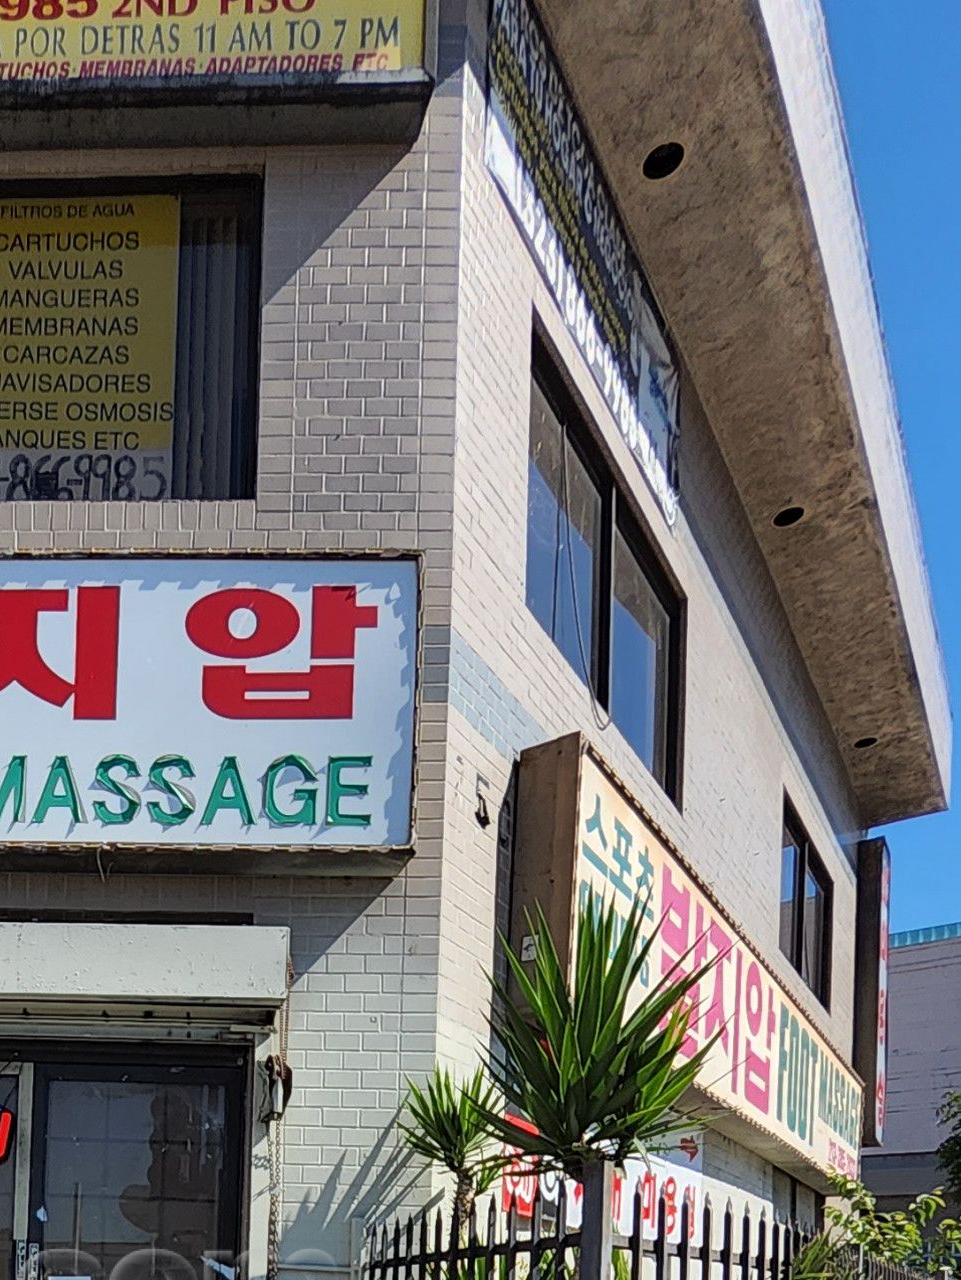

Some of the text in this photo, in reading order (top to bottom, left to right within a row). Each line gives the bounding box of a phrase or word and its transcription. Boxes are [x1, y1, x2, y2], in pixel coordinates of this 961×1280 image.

[14, 26, 68, 58] POR
[80, 23, 181, 56] DETRAS
[194, 22, 216, 53] 11
[228, 19, 272, 52] AM
[285, 18, 322, 51] TO
[333, 18, 348, 50] 7
[359, 15, 399, 49] PM
[78, 57, 196, 79] MEMBRANAS
[205, 53, 344, 75] ADAPTADORES
[0, 202, 135, 219] FILTROS DE AGUA
[8, 260, 124, 281] VALVULAS
[3, 345, 130, 365] CARCAZAS
[65, 401, 174, 422] OSMOSIS
[94, 431, 140, 450] ETC
[776, 1002, 819, 1148] FOOT
